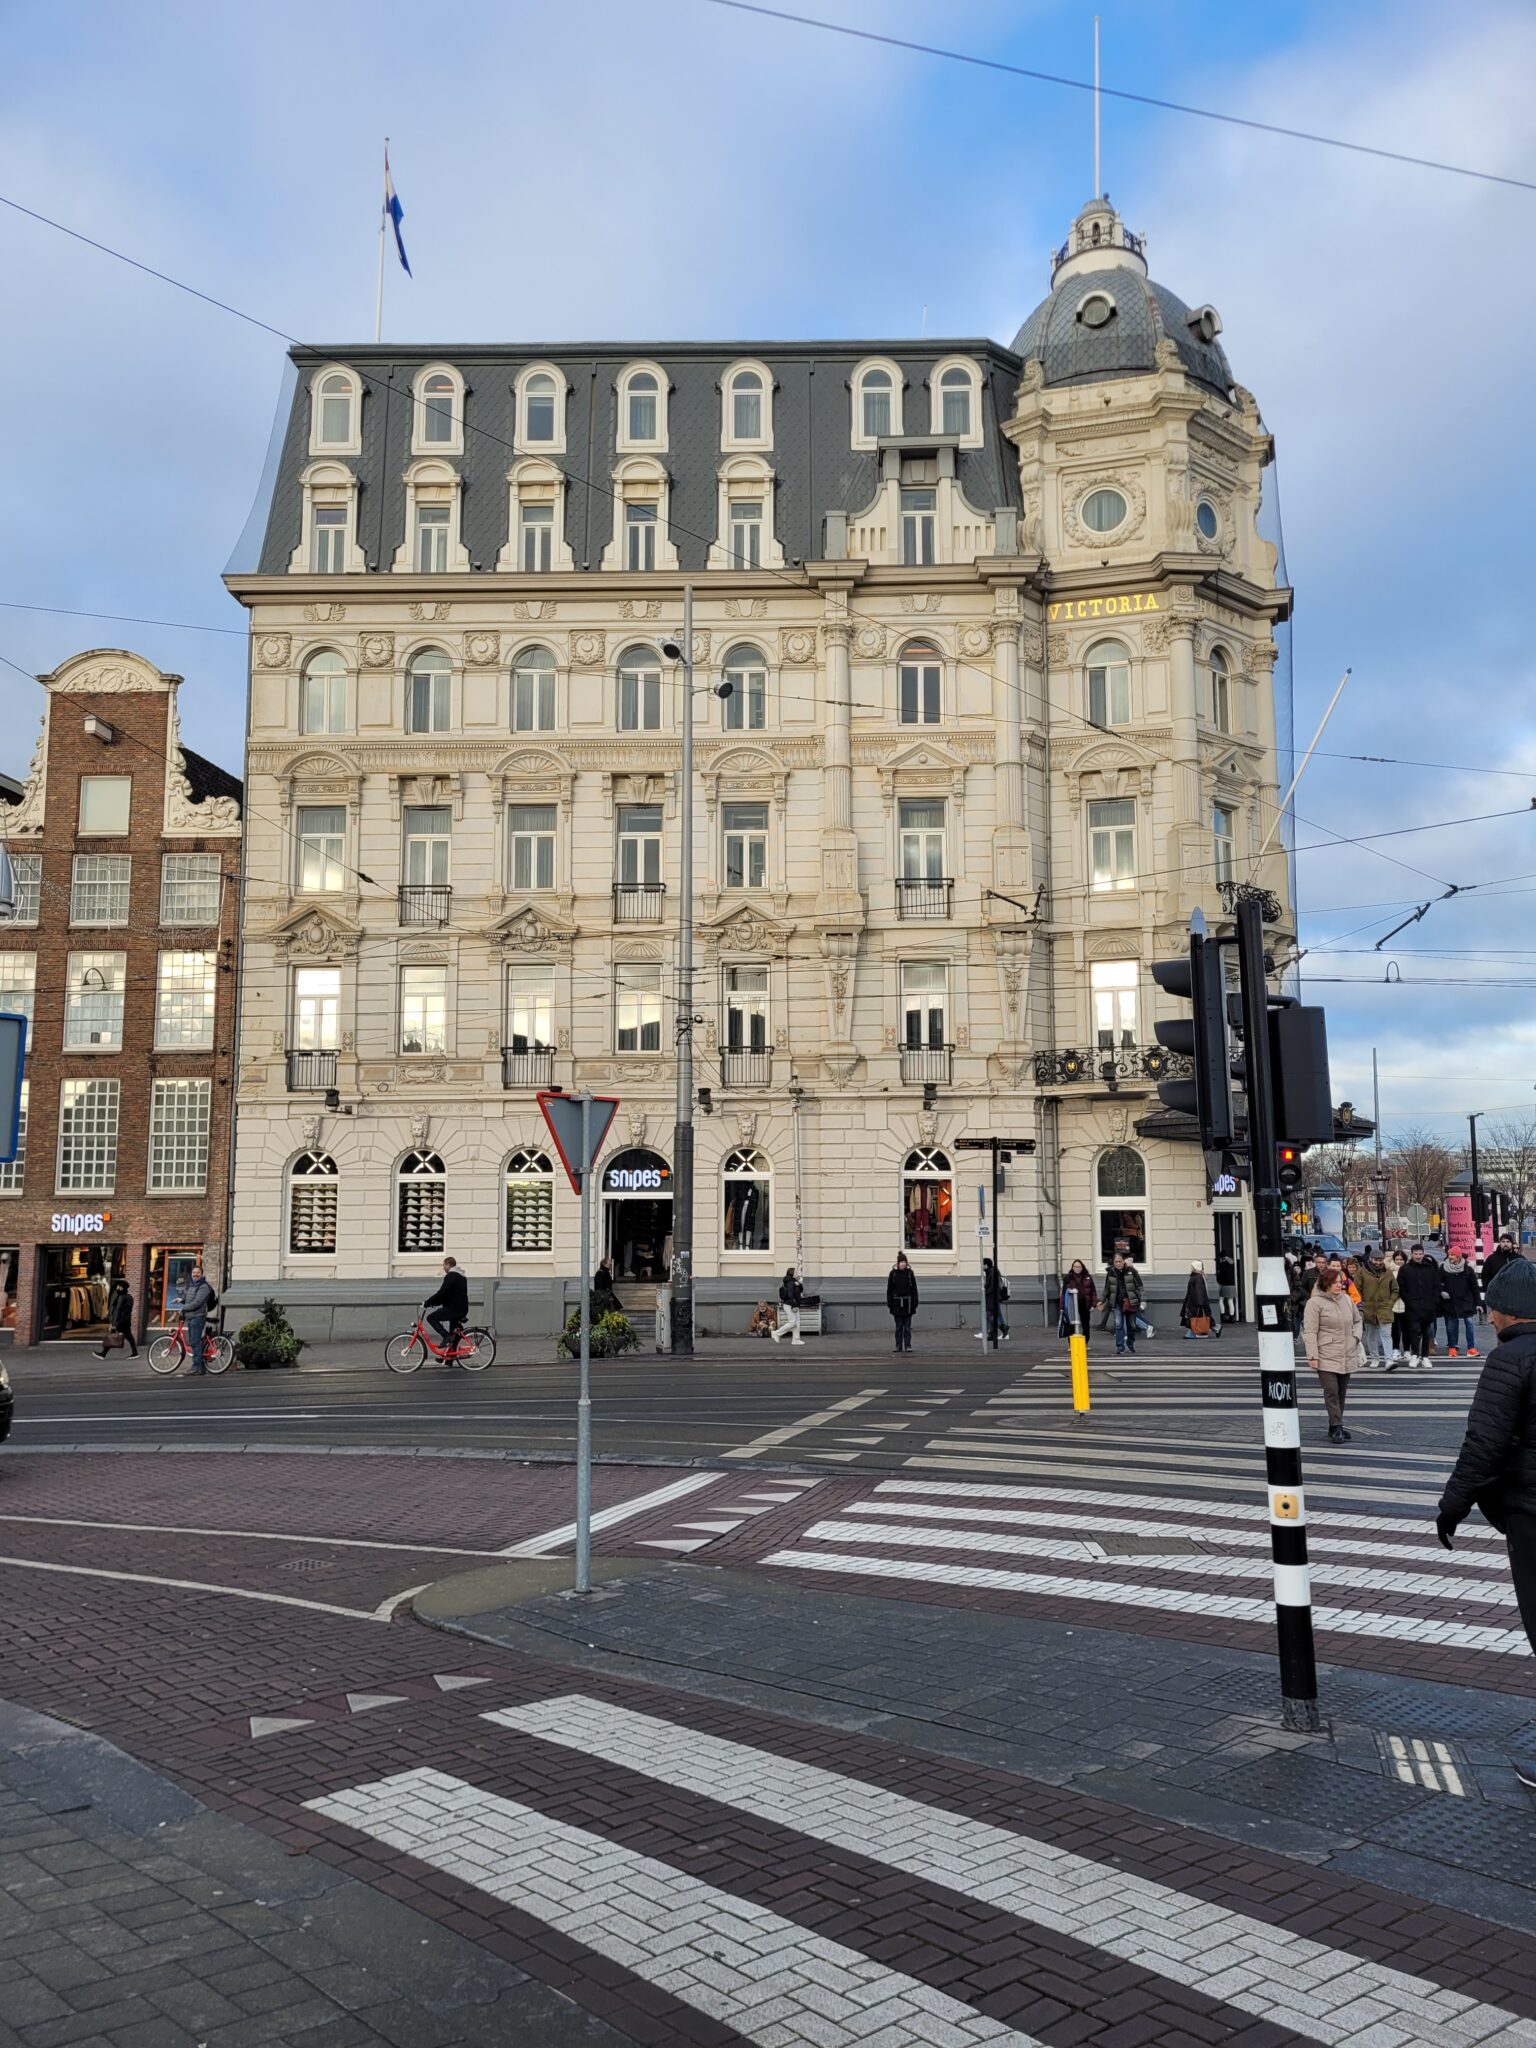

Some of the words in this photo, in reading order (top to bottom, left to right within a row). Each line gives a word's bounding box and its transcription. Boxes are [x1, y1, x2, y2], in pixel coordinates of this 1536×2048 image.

[1048, 593, 1159, 620] VICTORIA
[610, 1168, 662, 1191] snipes
[51, 1212, 104, 1236] snipes
